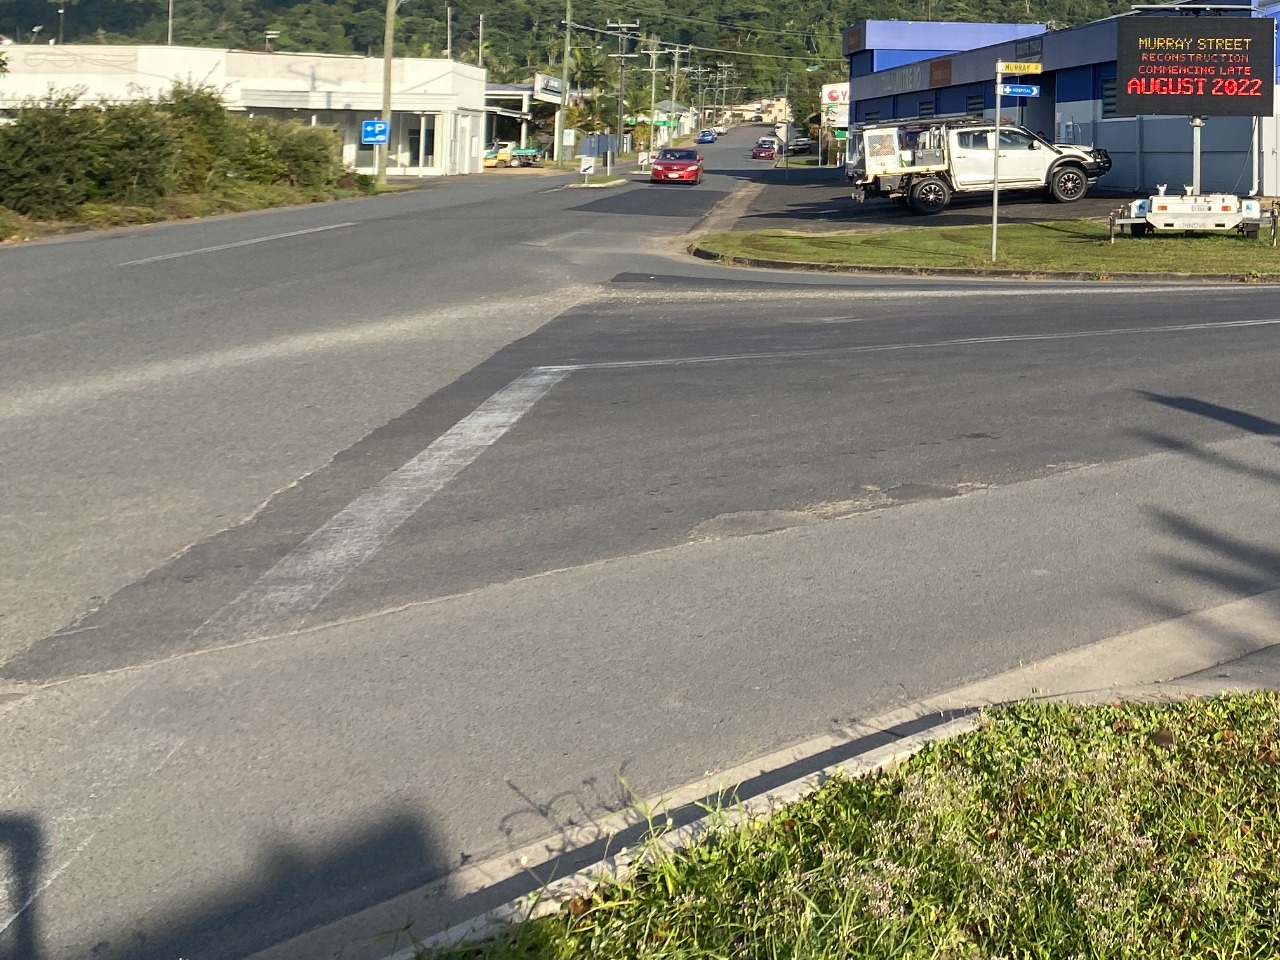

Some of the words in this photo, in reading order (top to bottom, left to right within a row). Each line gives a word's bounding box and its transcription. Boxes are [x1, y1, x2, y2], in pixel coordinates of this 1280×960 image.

[1138, 37, 1193, 50] MURRAY
[1197, 38, 1252, 51] STREET
[1141, 53, 1249, 63] RECONSTRUCTION
[1004, 63, 1031, 72] MURRAY
[1138, 65, 1215, 75] COMMENCING
[1219, 66, 1252, 76] LATE
[1127, 77, 1207, 95] AUGUST
[1211, 78, 1262, 96] 2022
[375, 123, 385, 134] P
